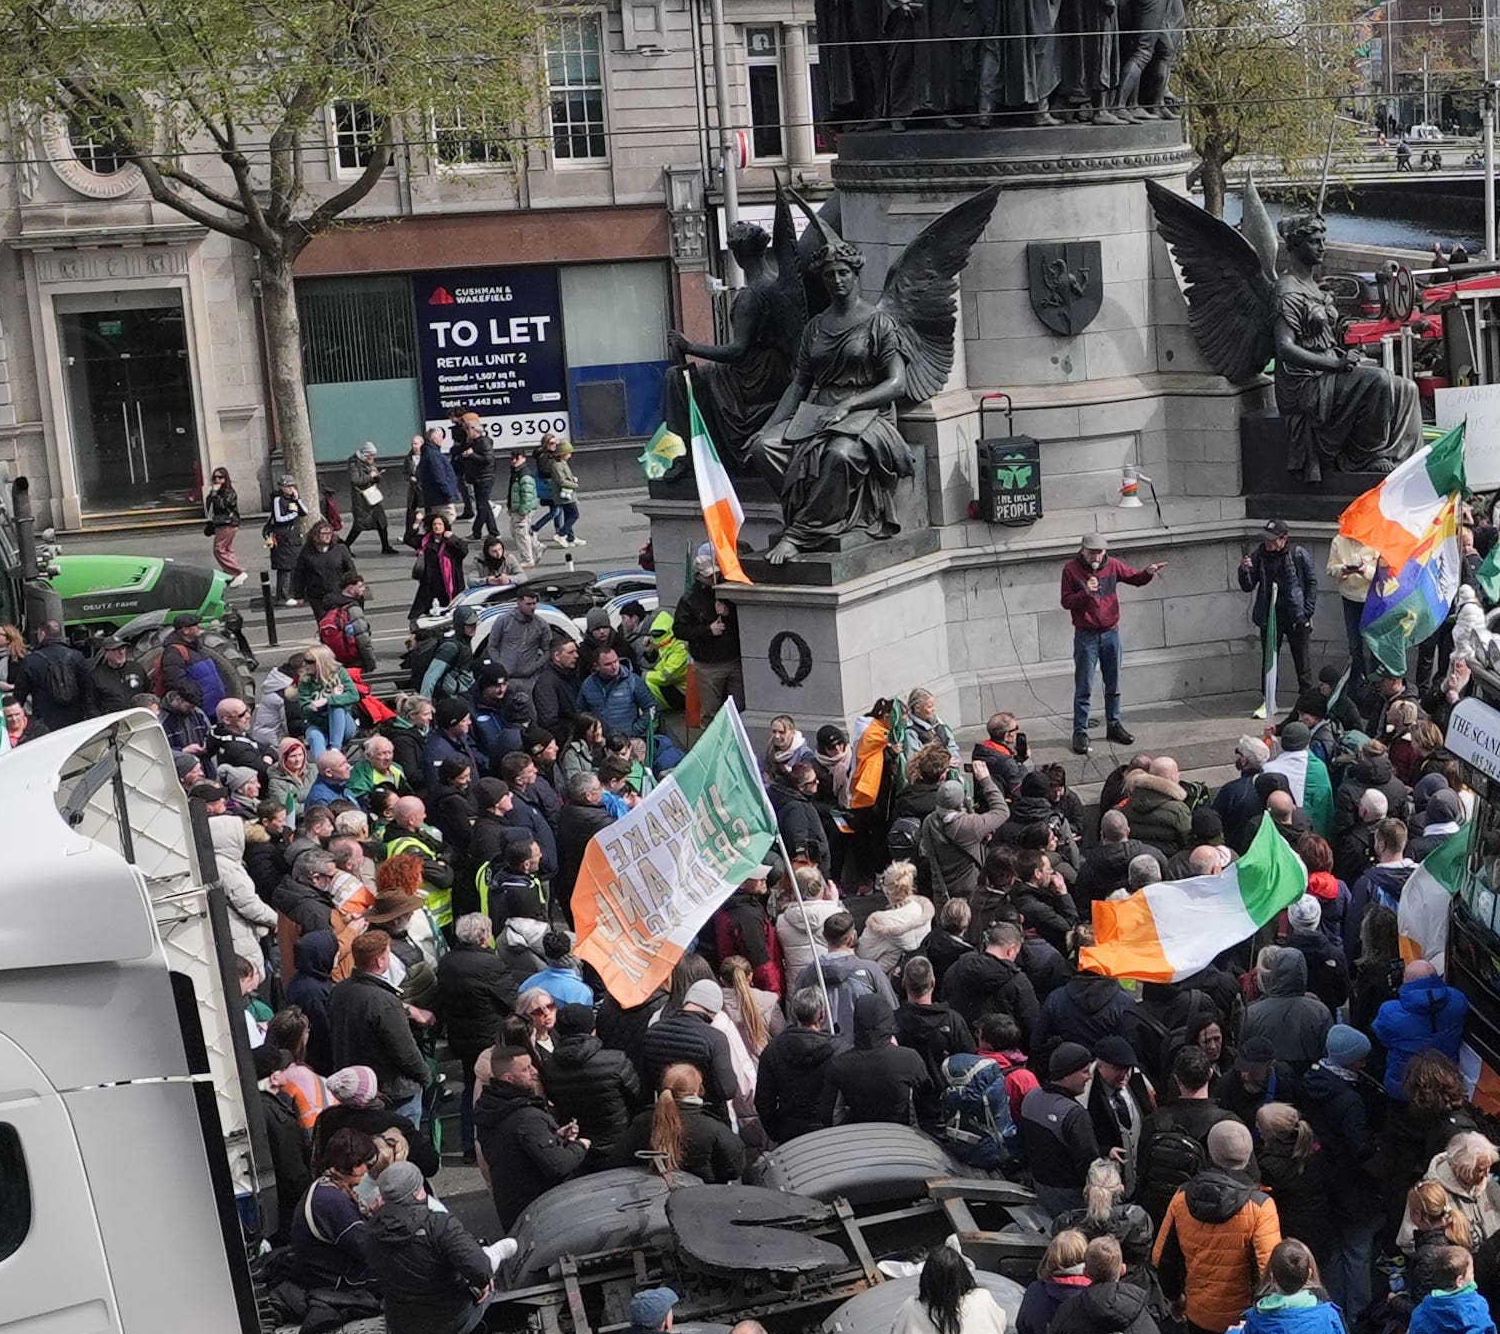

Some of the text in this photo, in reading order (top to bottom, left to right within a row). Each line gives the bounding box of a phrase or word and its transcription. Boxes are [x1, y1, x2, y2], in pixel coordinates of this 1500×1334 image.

[455, 286, 512, 297] CUSHMAN &
[456, 294, 513, 304] WAKEFIELD
[429, 316, 551, 348] TO LET
[437, 353, 527, 369] RETAIL UNIT 2
[438, 374, 468, 383] Ground
[439, 384, 478, 392] Basement
[440, 400, 461, 408] Total
[511, 418, 566, 436] 9300
[996, 501, 1037, 519] PEOPLE
[1452, 714, 1472, 737] THE
